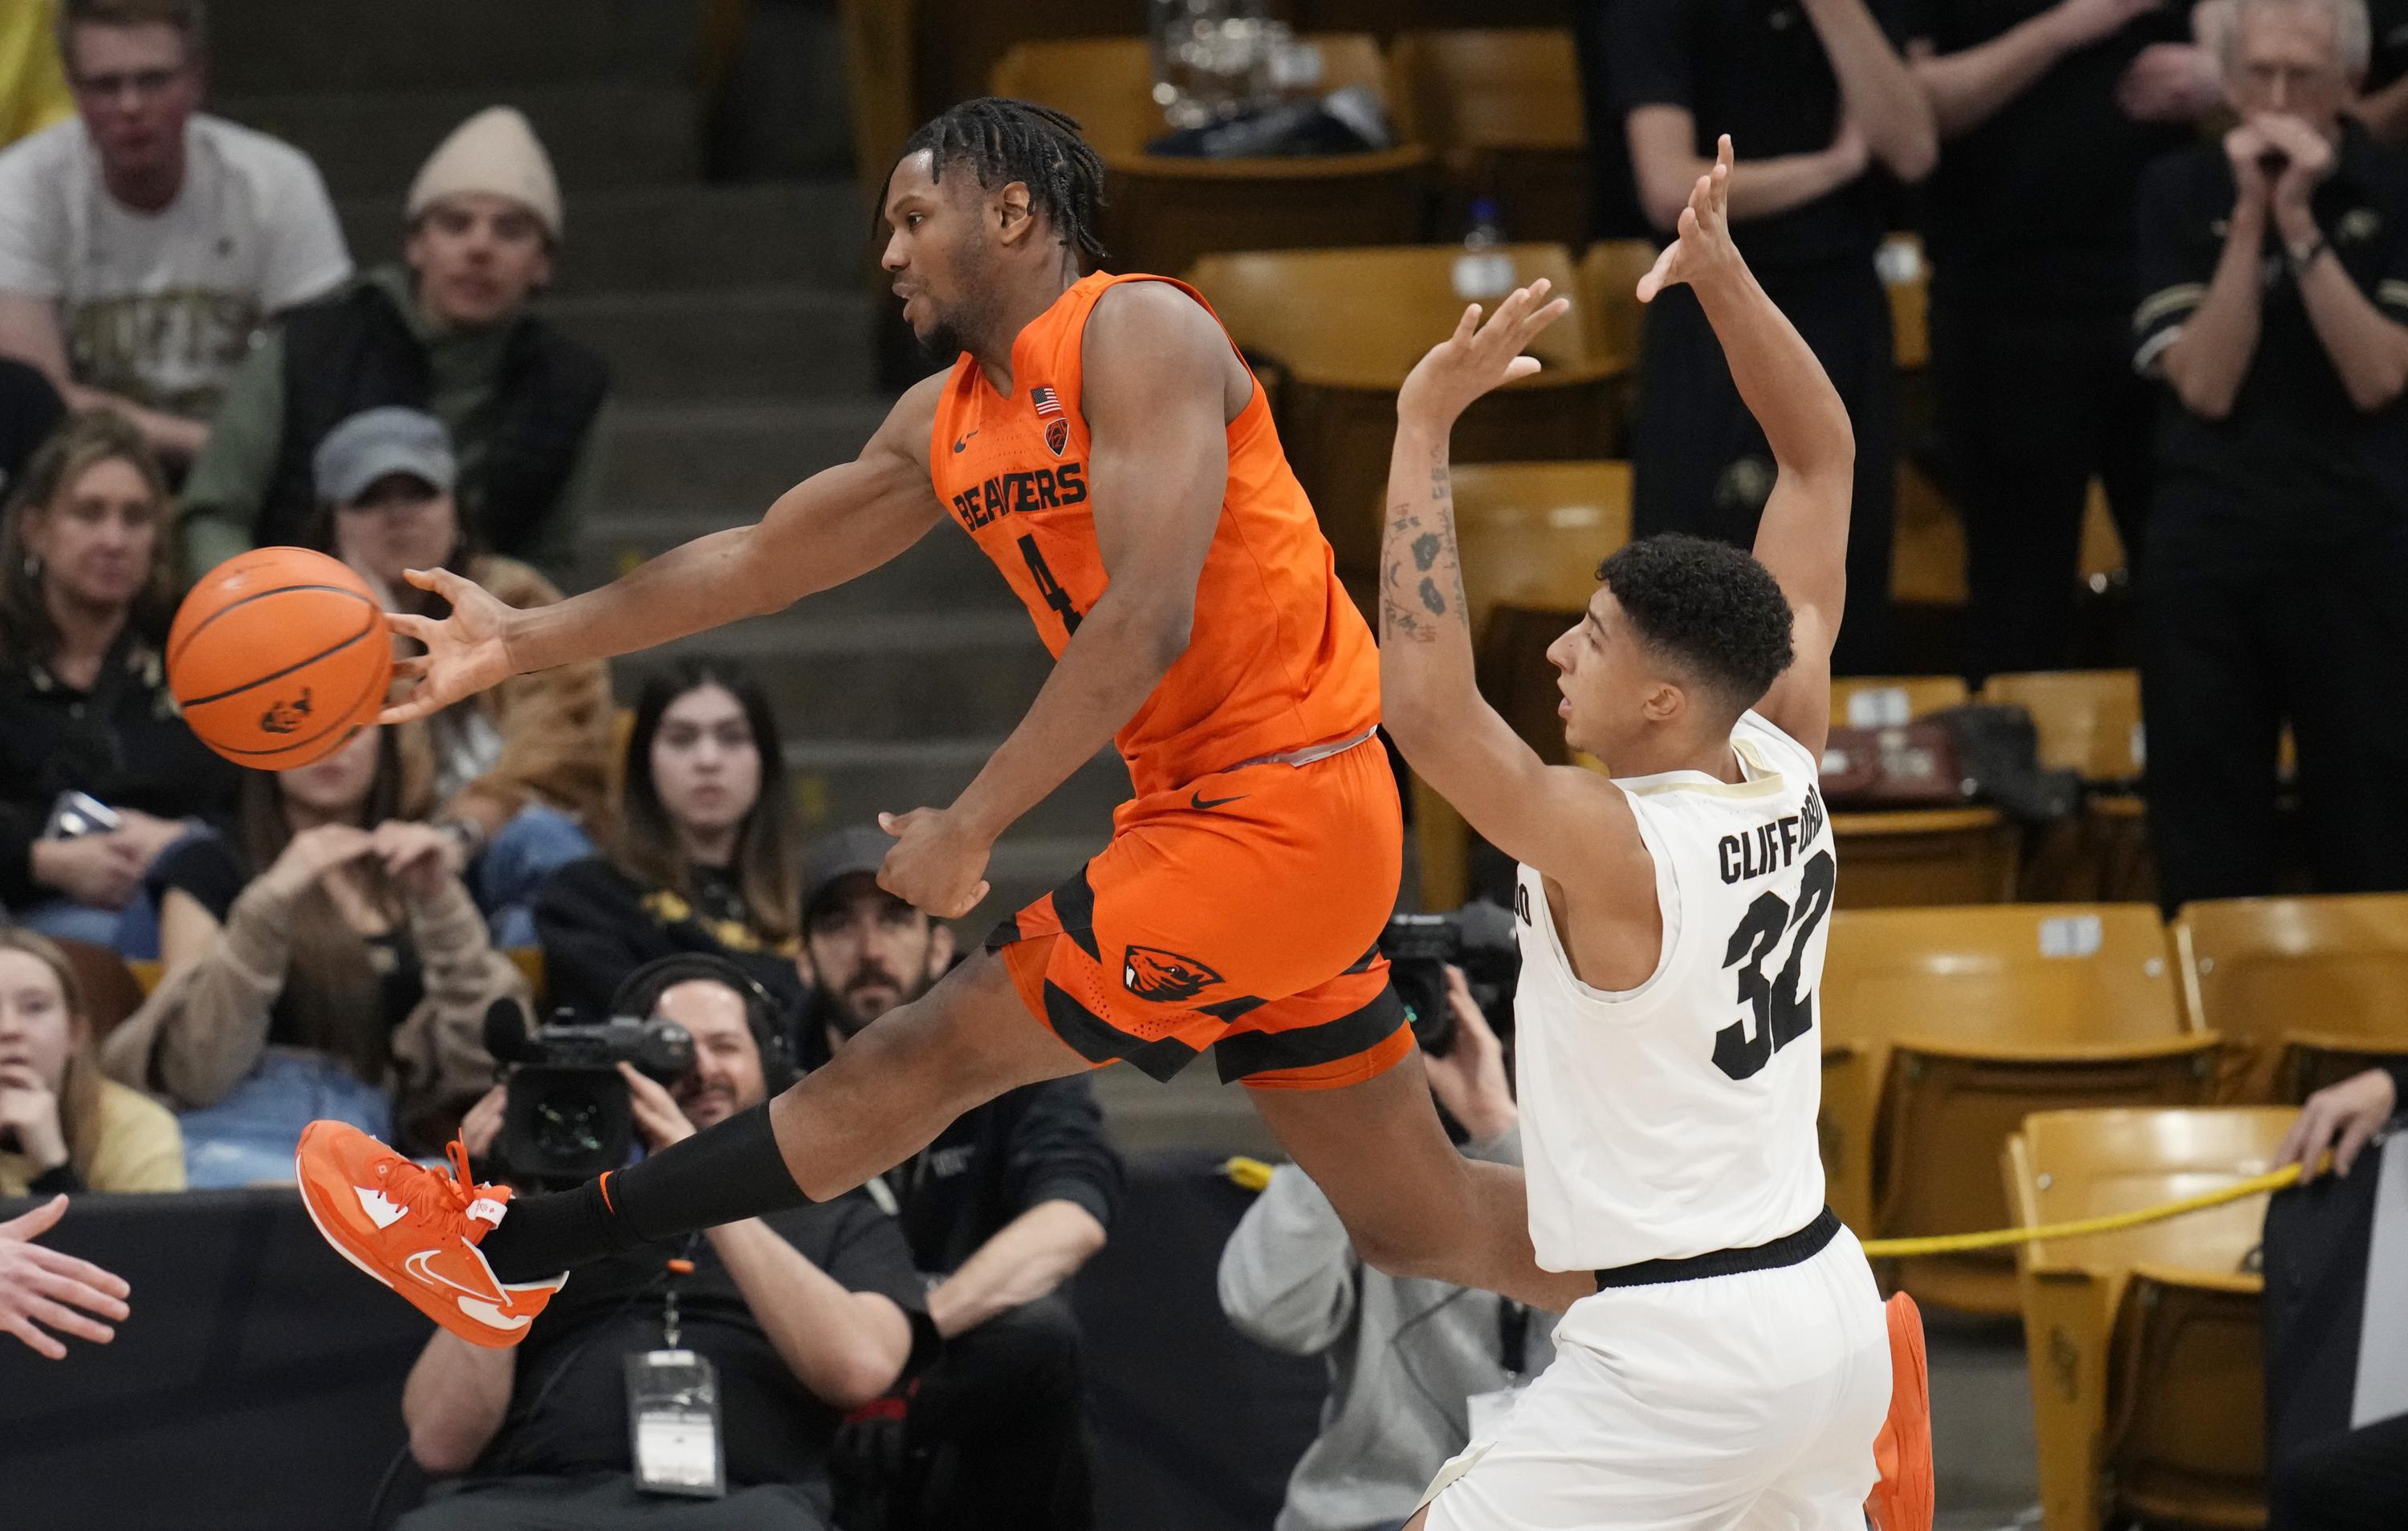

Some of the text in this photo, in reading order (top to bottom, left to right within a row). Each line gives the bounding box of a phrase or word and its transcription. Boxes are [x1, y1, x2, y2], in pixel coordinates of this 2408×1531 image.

[953, 462, 1087, 532] BEAVERS
[1017, 534, 1083, 637] 4
[1719, 783, 1823, 884] CLIFFORD
[1711, 849, 1834, 1080] 32
